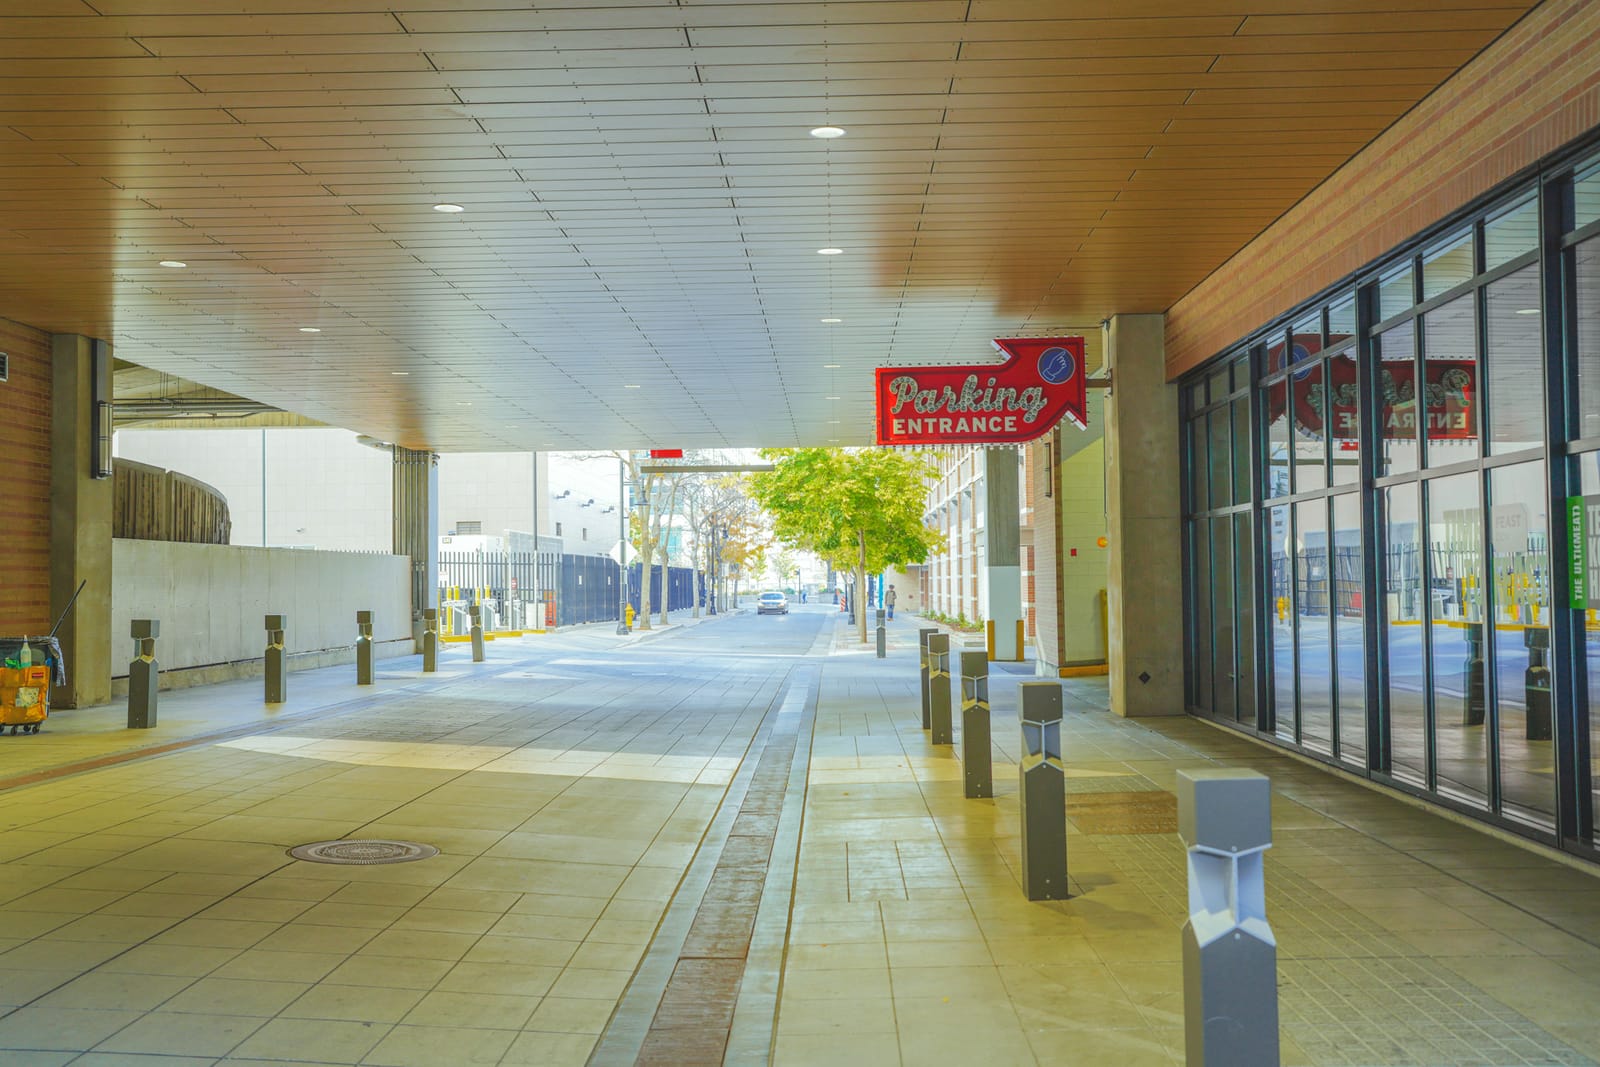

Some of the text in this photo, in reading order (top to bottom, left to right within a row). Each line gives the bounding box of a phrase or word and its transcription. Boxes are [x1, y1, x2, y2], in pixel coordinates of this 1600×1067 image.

[890, 374, 1047, 423] Parking
[893, 416, 1017, 435] ENTRANCE
[1574, 578, 1583, 601] THE
